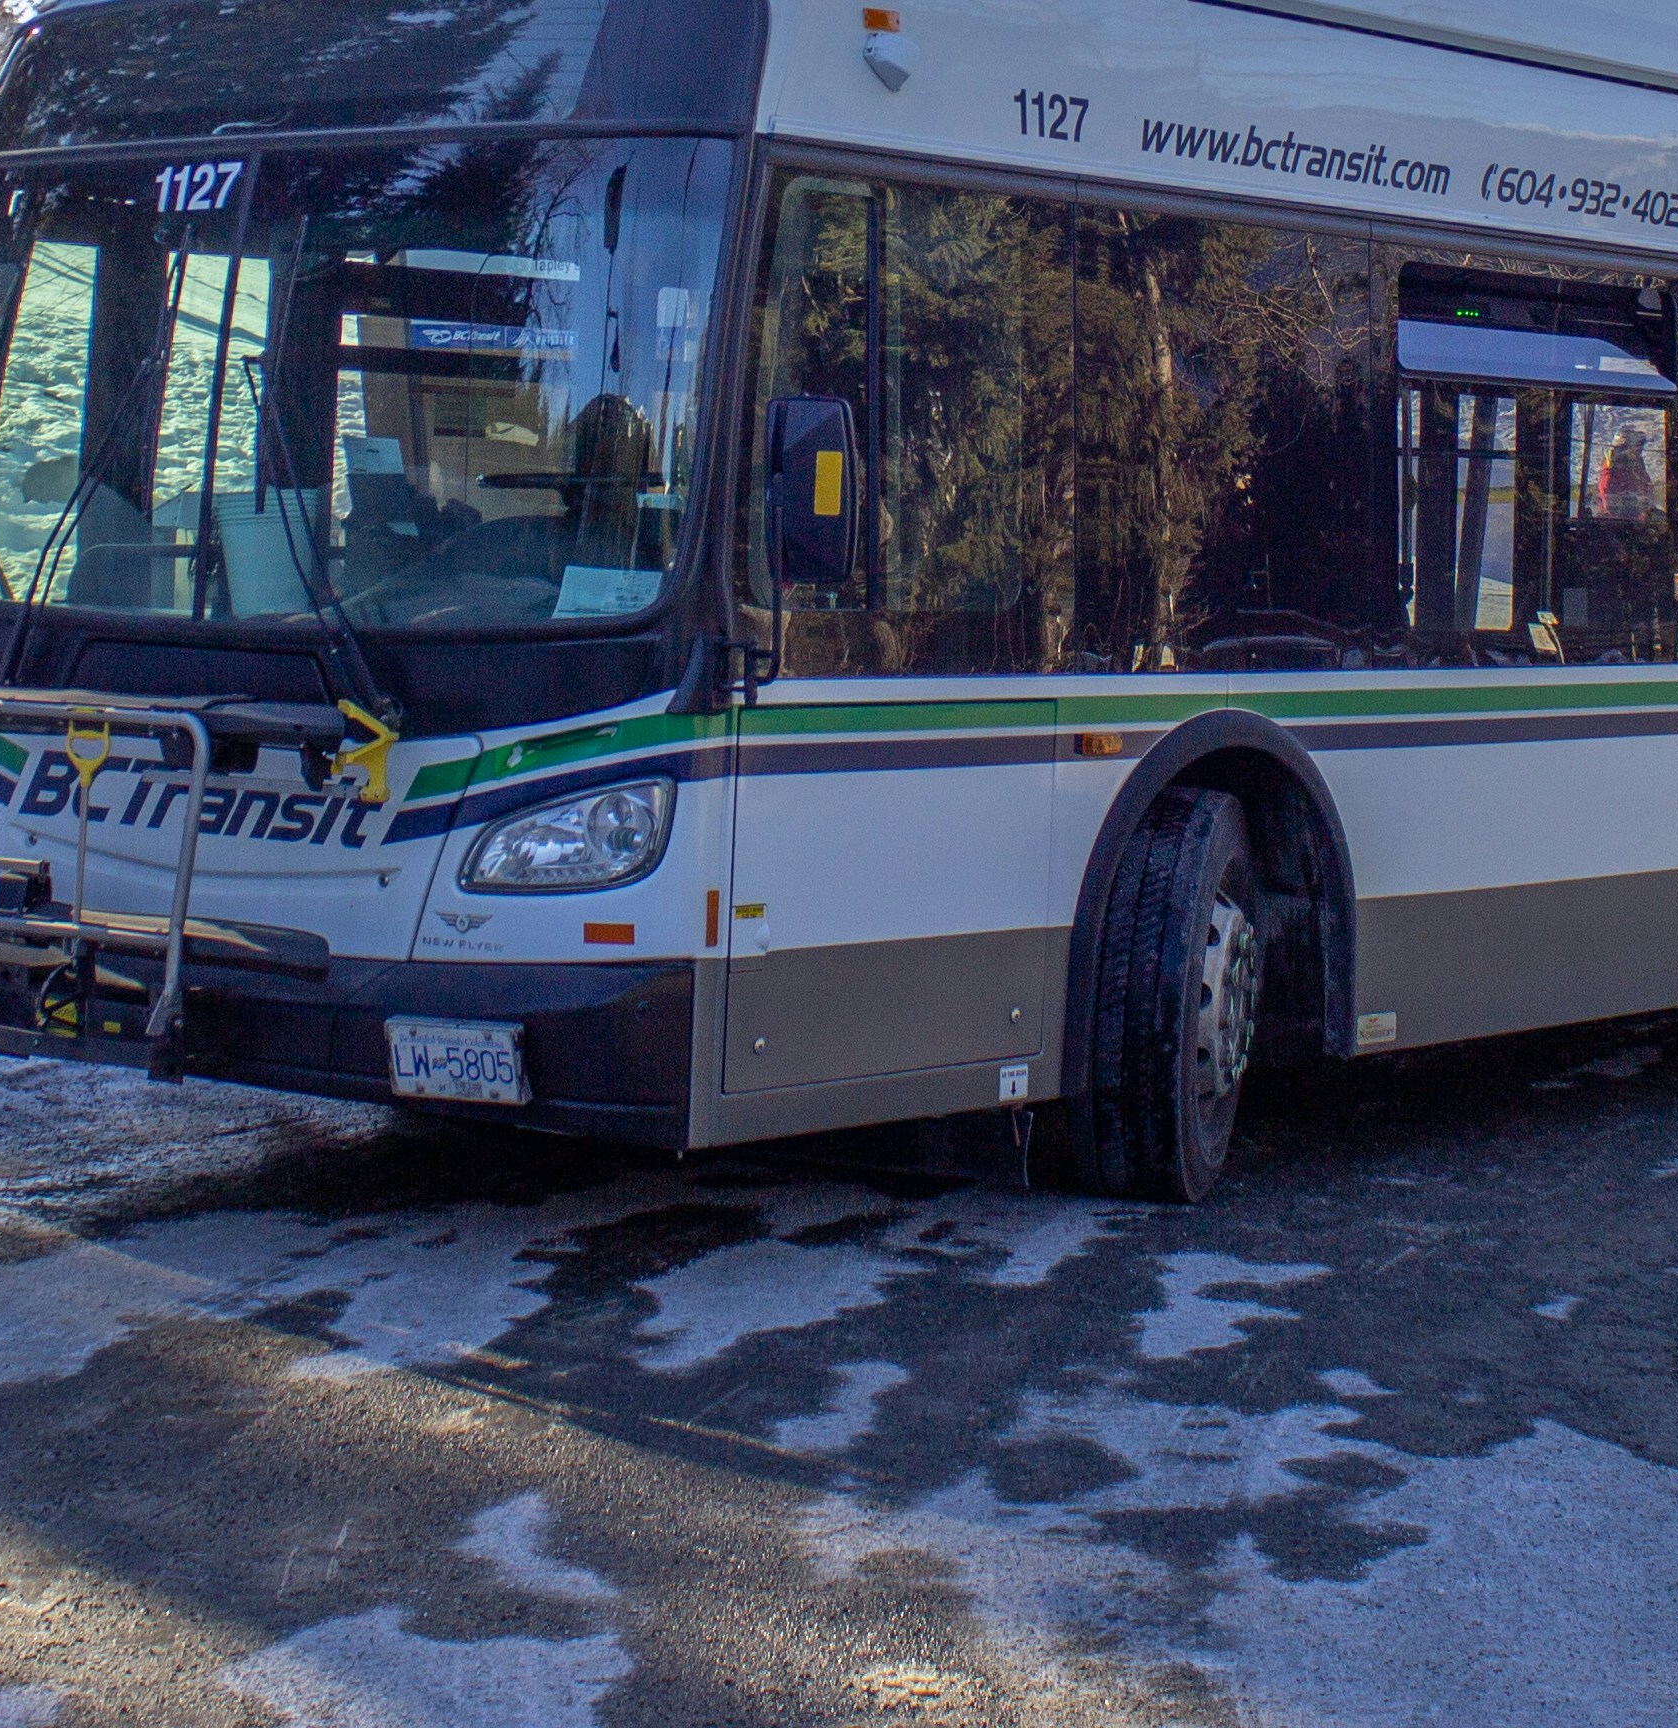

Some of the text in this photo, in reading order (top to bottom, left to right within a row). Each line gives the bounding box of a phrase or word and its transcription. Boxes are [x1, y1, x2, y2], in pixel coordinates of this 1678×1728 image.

[1013, 88, 1089, 143] 1127
[1141, 119, 1451, 195] www.bctransit.com
[155, 162, 243, 212] 1127
[423, 936, 503, 952] NEW FLYER
